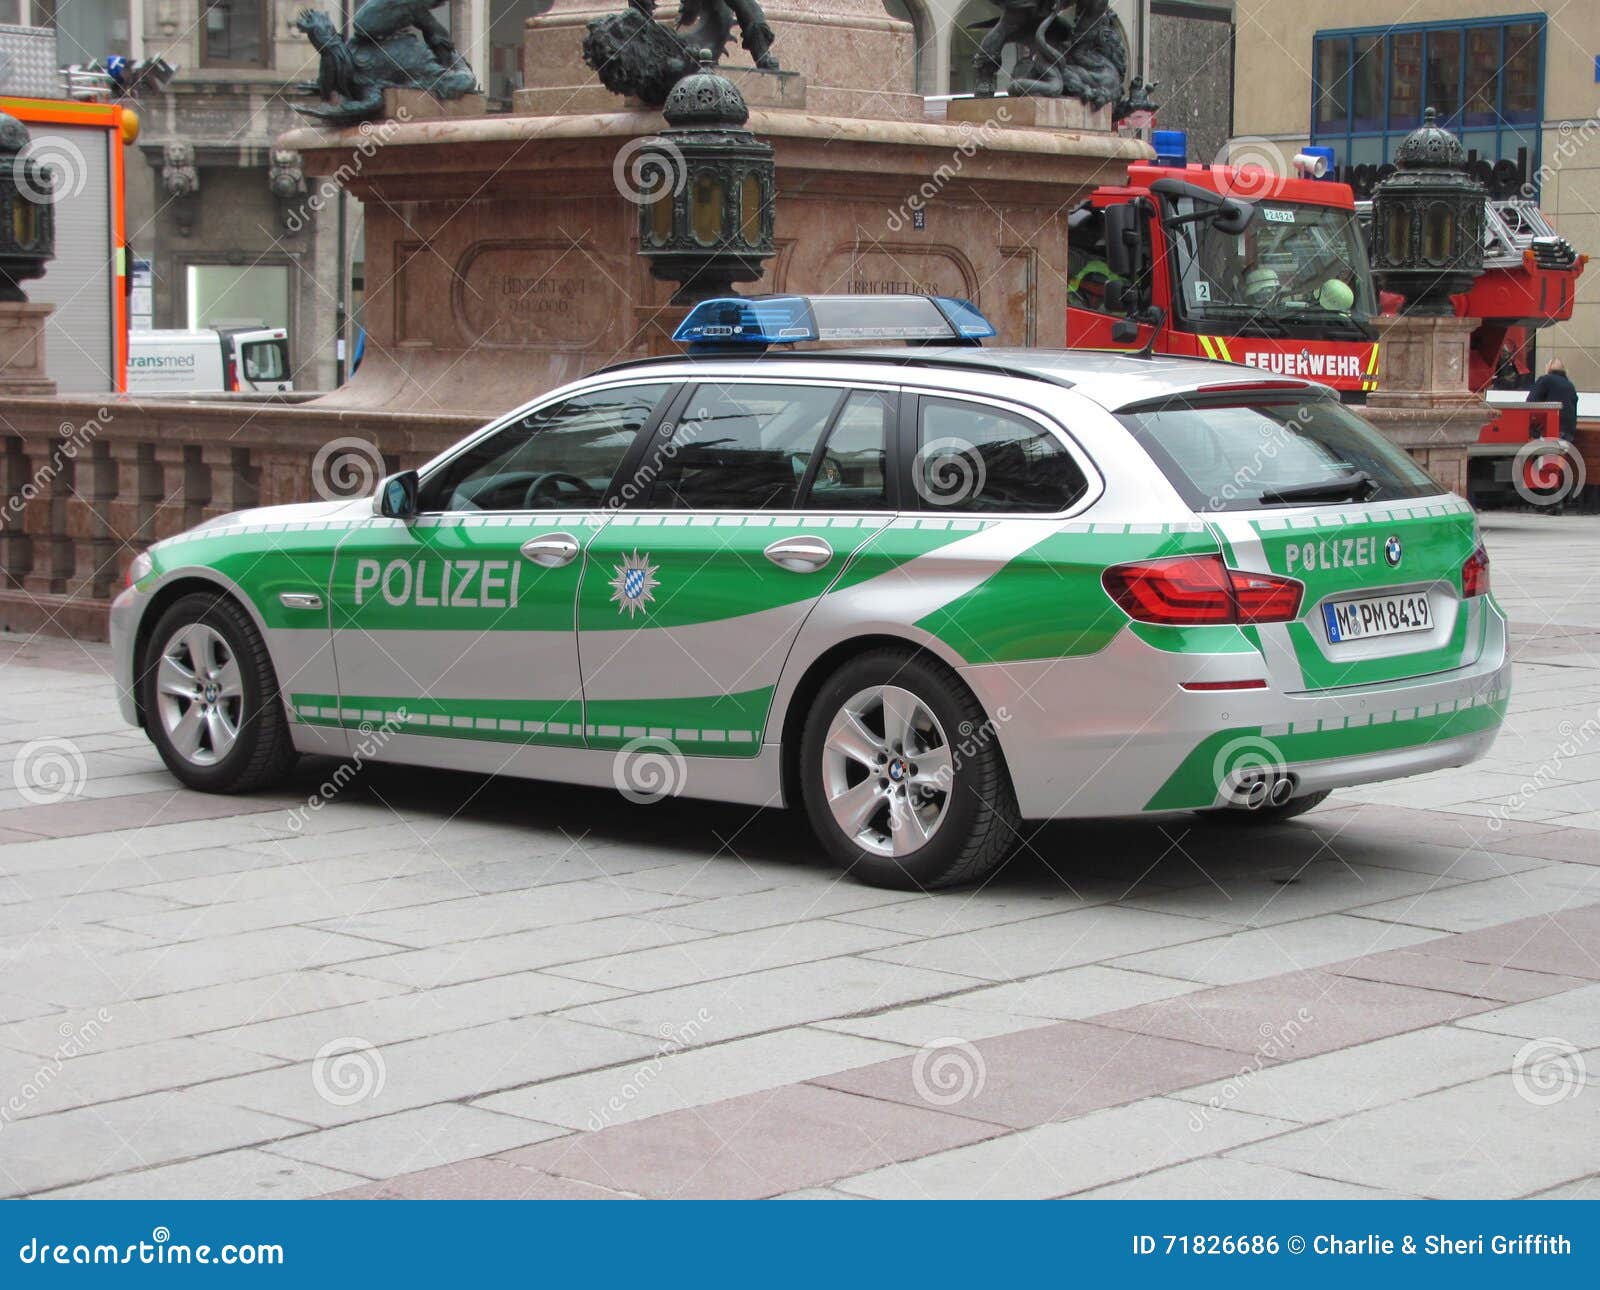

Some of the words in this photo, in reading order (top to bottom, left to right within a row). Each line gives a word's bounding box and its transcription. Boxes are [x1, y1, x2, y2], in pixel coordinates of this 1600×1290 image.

[1199, 284, 1208, 298] 2
[1245, 352, 1360, 376] FEUERWEHR
[1285, 536, 1376, 573] POLIZEI
[354, 558, 521, 608] POLIZEI
